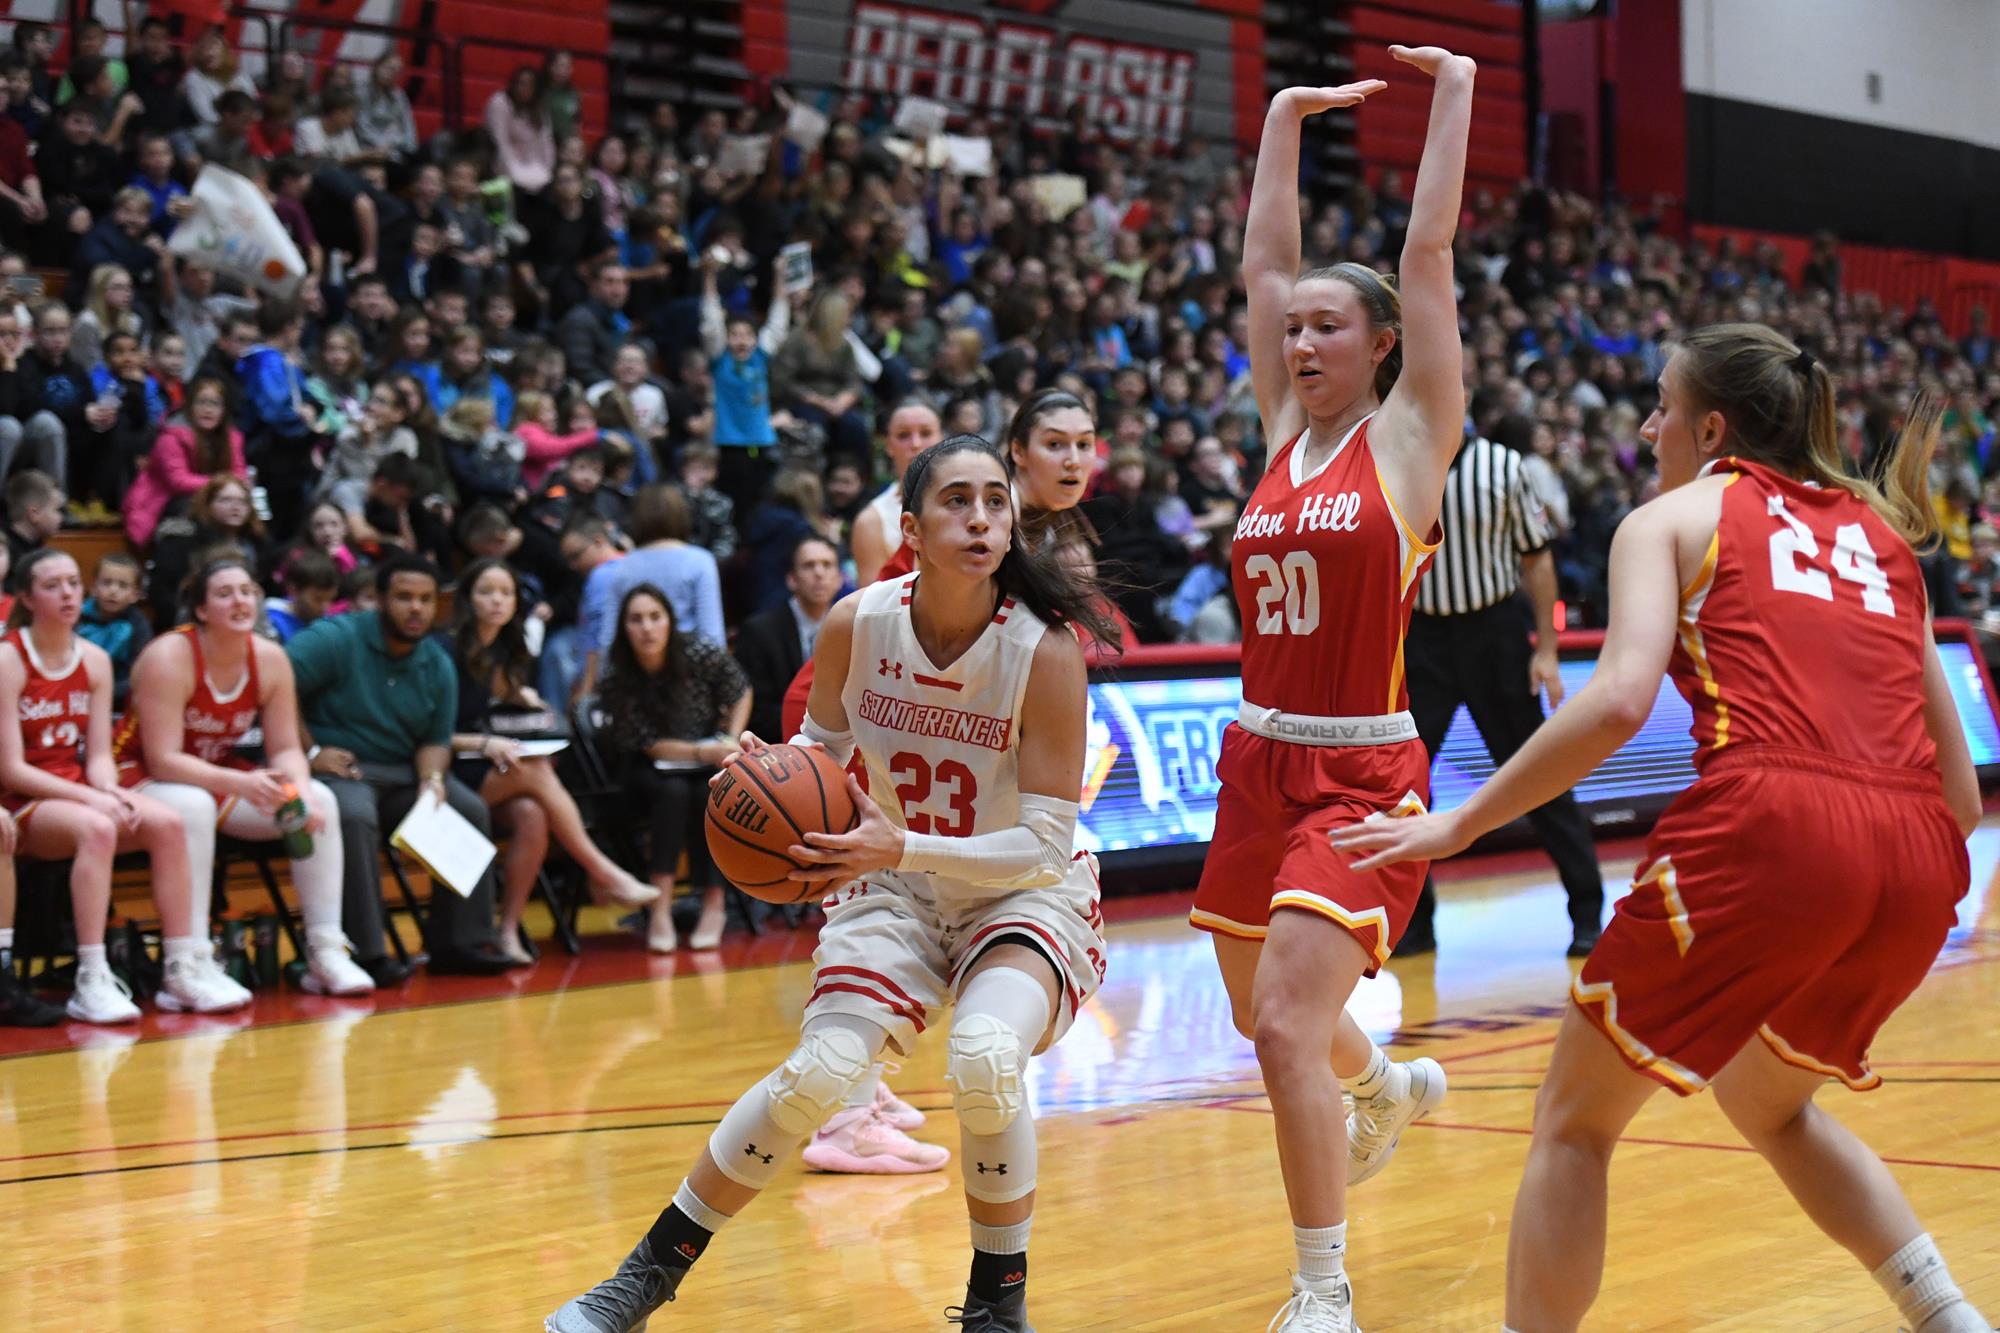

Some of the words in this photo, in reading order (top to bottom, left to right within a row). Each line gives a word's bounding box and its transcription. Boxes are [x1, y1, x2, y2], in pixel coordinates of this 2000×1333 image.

[1233, 505, 1285, 541] eton
[1296, 491, 1361, 535] Hill
[1767, 494, 1896, 618] 24
[1245, 550, 1320, 636] 20
[859, 689, 914, 731] SAINT
[908, 704, 1012, 752] FRANCIS
[1277, 720, 1360, 739] ARMO
[1369, 718, 1415, 738] DER
[725, 788, 770, 835] THE
[890, 751, 978, 839] 23
